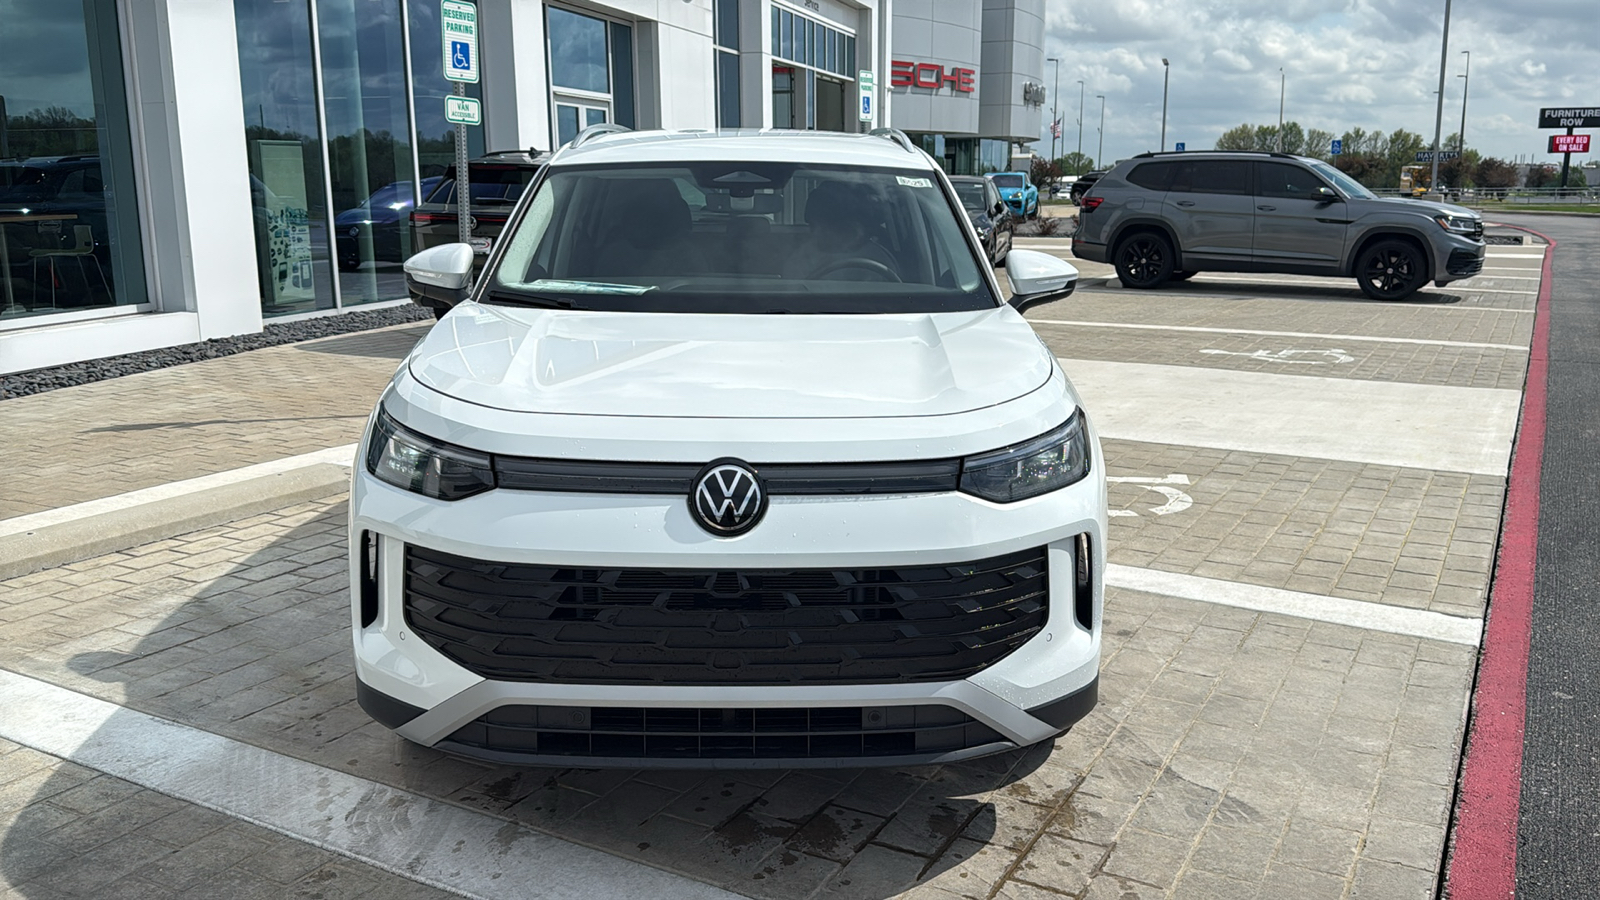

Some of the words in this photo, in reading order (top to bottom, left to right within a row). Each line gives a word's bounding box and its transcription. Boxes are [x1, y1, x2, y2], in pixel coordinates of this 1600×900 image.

[443, 9, 475, 22] RESERVED
[446, 22, 473, 35] PARKING
[457, 102, 470, 111] VAN
[451, 111, 476, 119] ACCESSIBLE
[1545, 109, 1600, 118] FURNITURE
[1560, 118, 1584, 127] ROW
[1555, 136, 1575, 144] EVERY
[1575, 136, 1588, 144] BED
[1568, 143, 1584, 151] SALE
[1417, 151, 1459, 159] HAVRTYS
